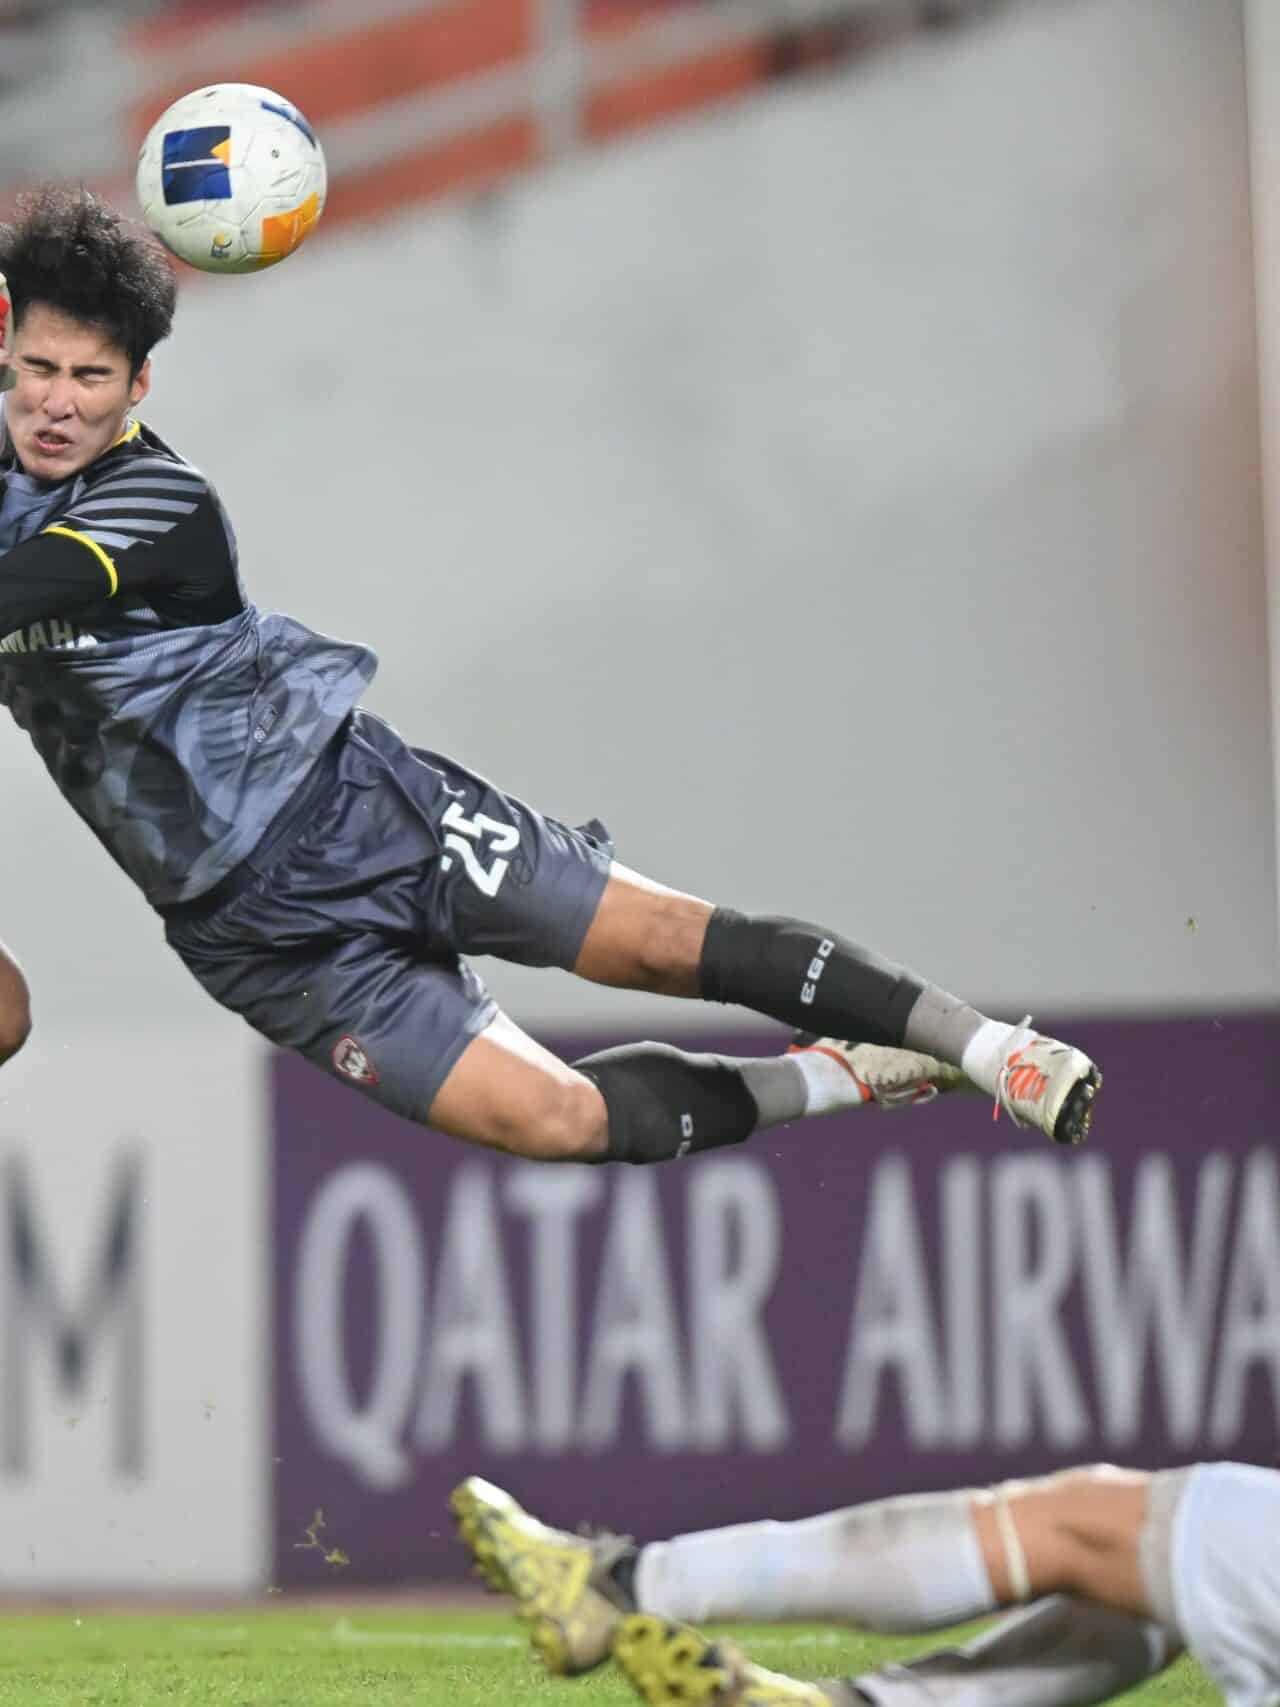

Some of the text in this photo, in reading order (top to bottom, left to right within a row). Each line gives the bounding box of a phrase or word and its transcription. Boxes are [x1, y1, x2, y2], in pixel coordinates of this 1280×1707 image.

[441, 801, 520, 897] 25
[800, 938, 835, 1005] EGO
[295, 1158, 792, 1488] QATAR
